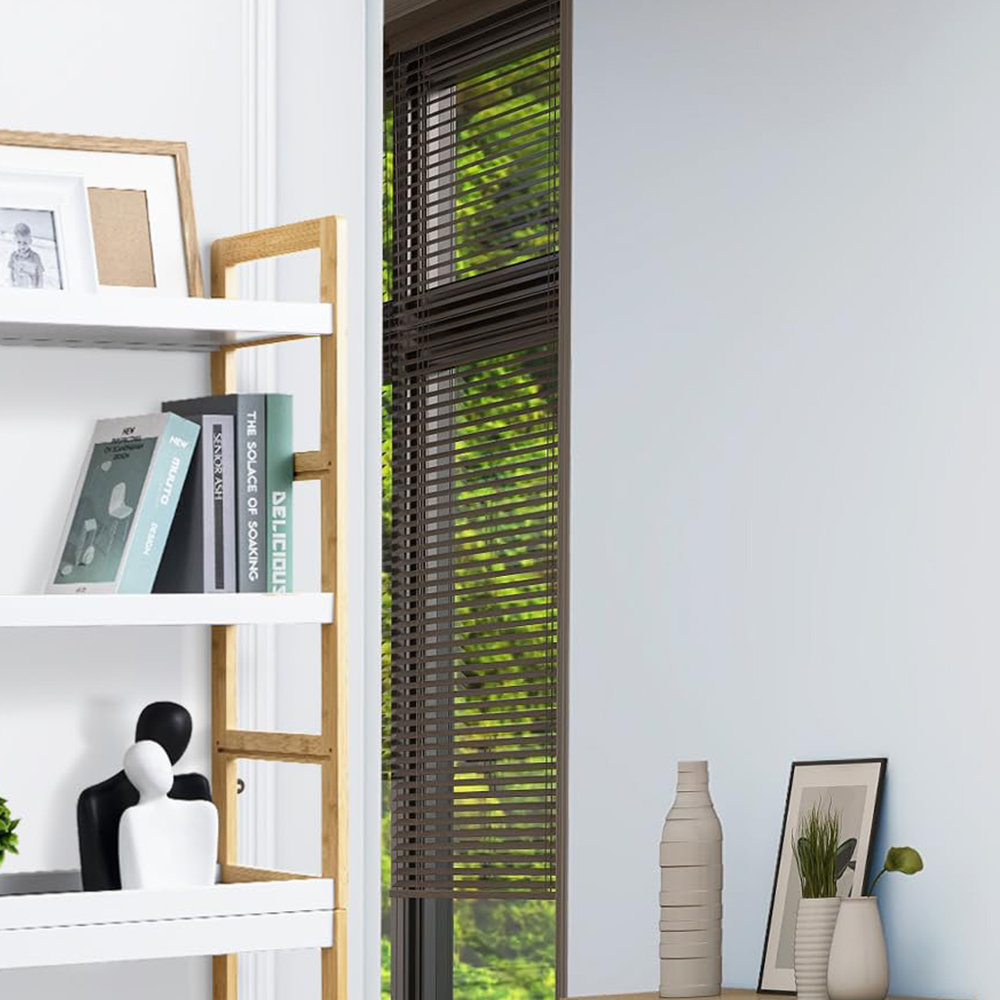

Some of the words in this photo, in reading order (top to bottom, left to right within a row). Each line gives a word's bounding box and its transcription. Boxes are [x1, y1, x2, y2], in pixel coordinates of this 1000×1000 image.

[246, 411, 257, 437] THE
[246, 441, 258, 493] SOLACE
[247, 497, 258, 515] OF
[248, 520, 259, 582] SOAKING
